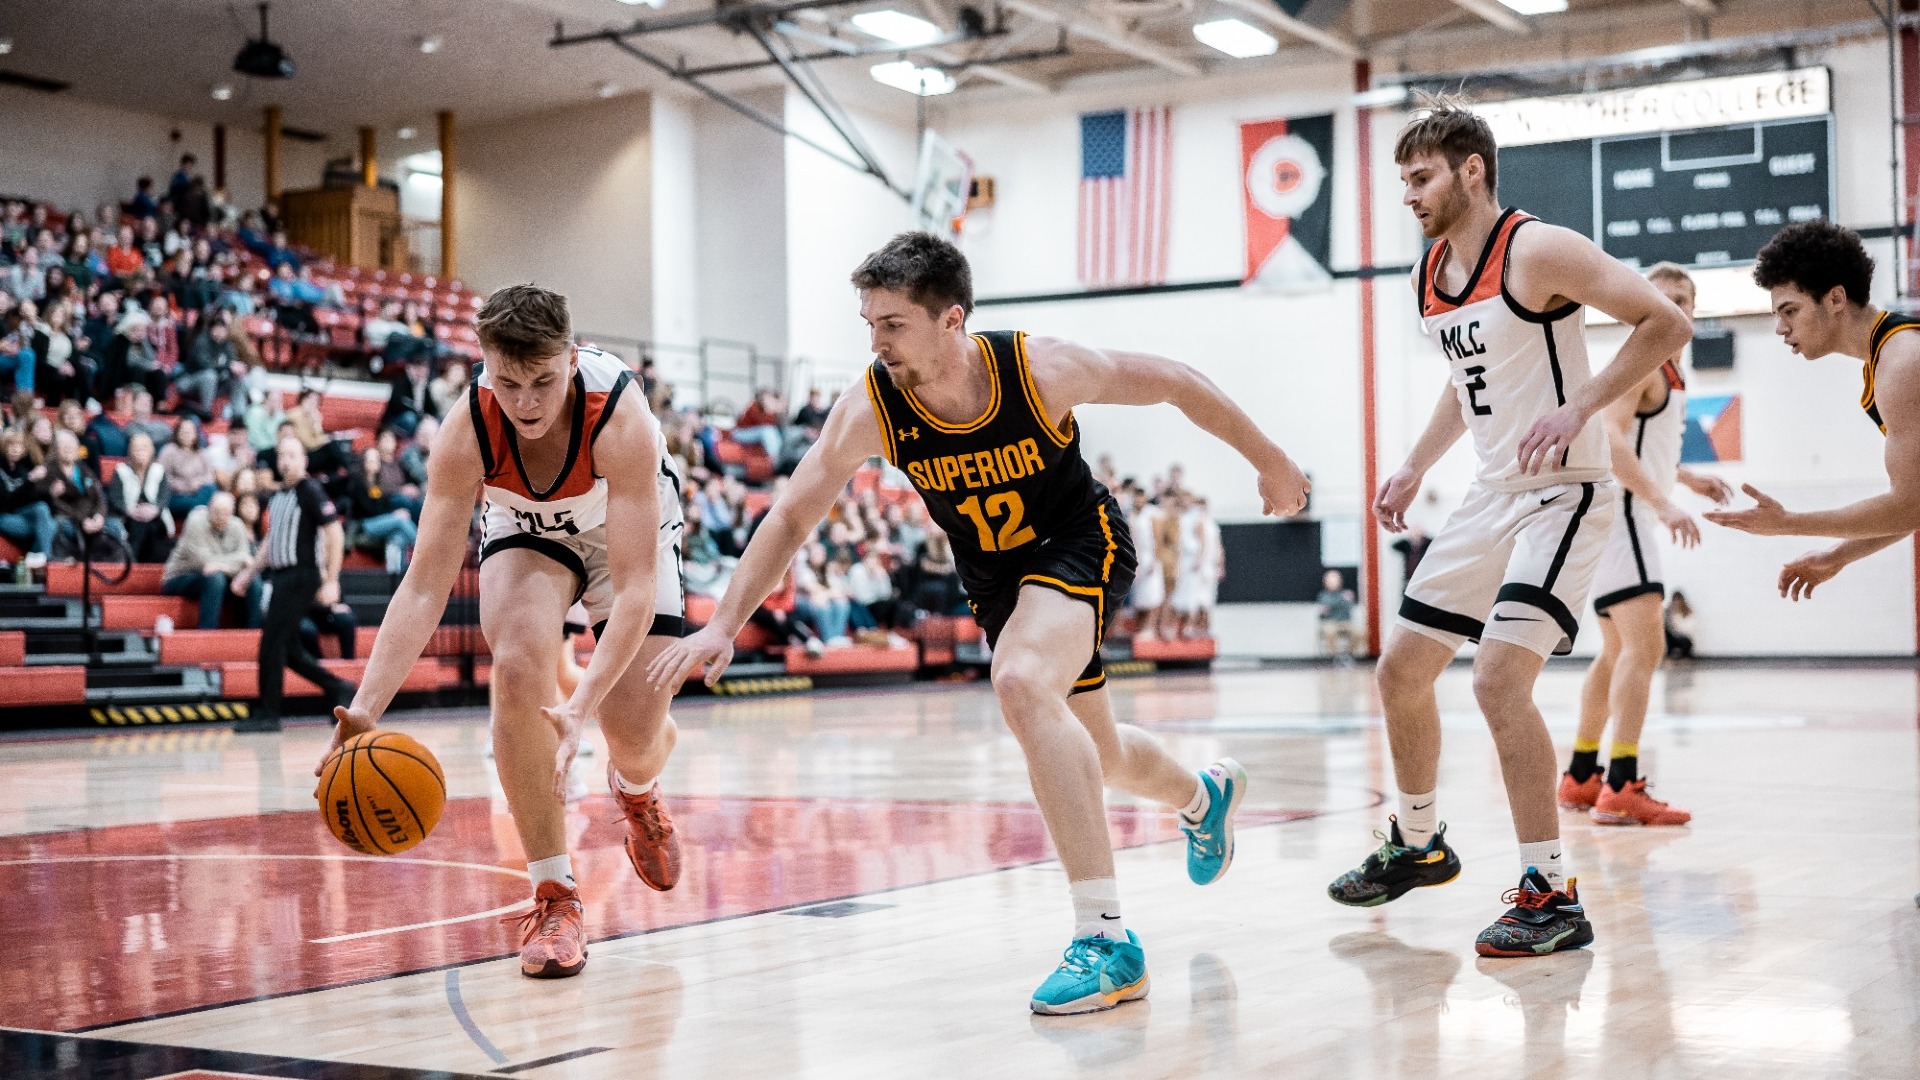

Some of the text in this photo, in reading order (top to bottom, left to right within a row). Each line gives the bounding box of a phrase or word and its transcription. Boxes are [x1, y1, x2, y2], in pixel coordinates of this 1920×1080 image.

[1672, 79, 1815, 119] COLLEGE
[1440, 320, 1486, 361] MLC
[1464, 365, 1493, 416] 2
[907, 437, 1046, 491] SUPERIOR
[956, 490, 1037, 552] 12
